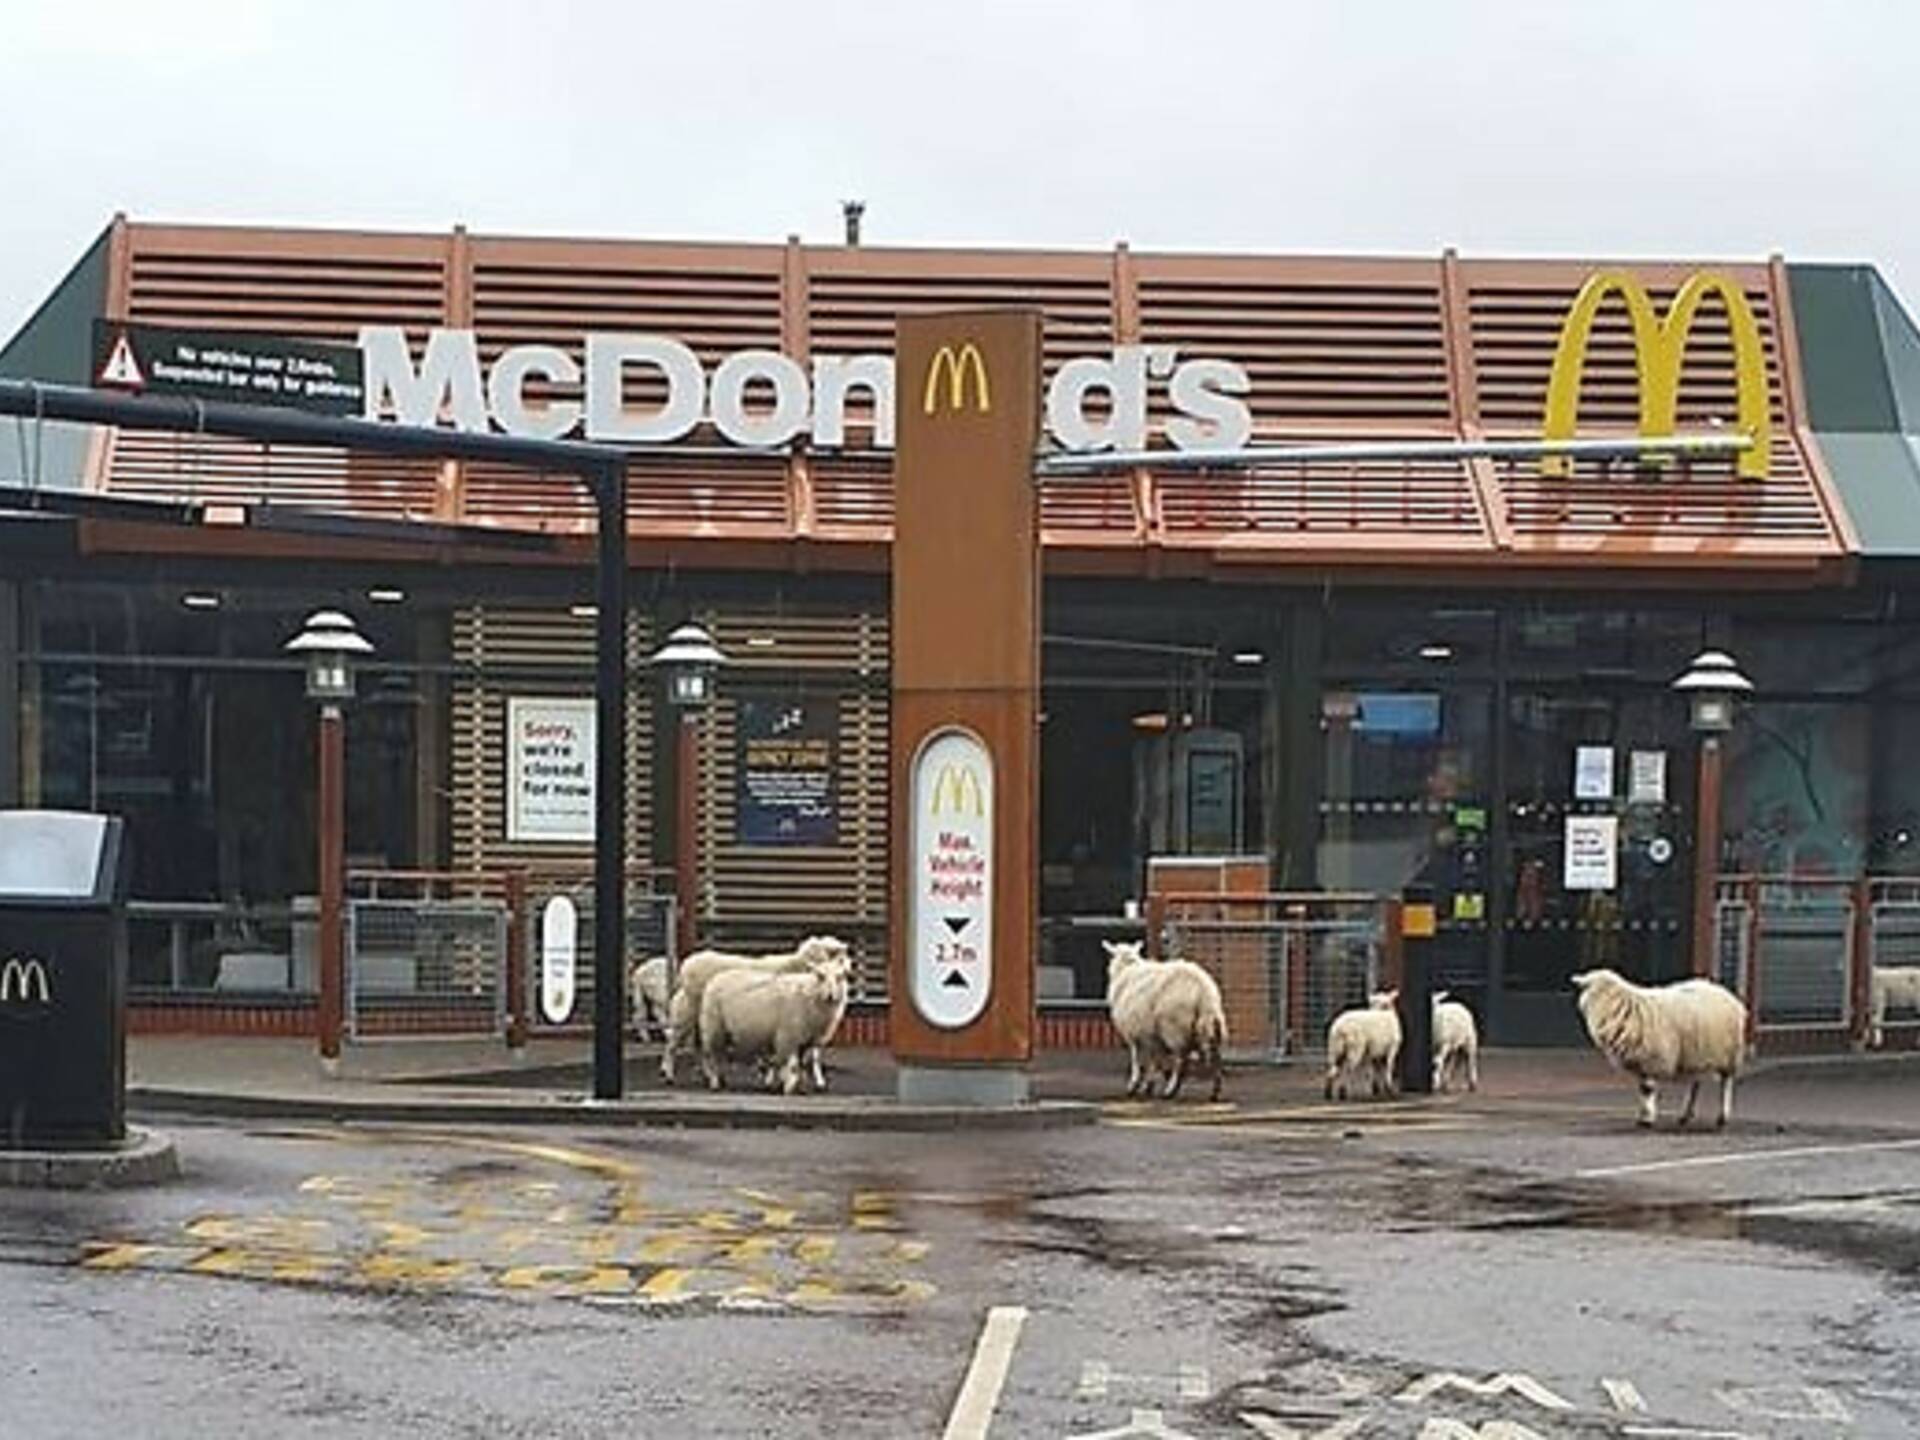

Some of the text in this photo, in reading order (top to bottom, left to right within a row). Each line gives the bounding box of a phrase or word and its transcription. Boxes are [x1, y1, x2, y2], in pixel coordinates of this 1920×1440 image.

[357, 326, 1252, 451] McDond's
[524, 762, 586, 777] closed
[524, 780, 591, 797] for now
[928, 853, 985, 873] Vehicle
[931, 879, 984, 901] Height
